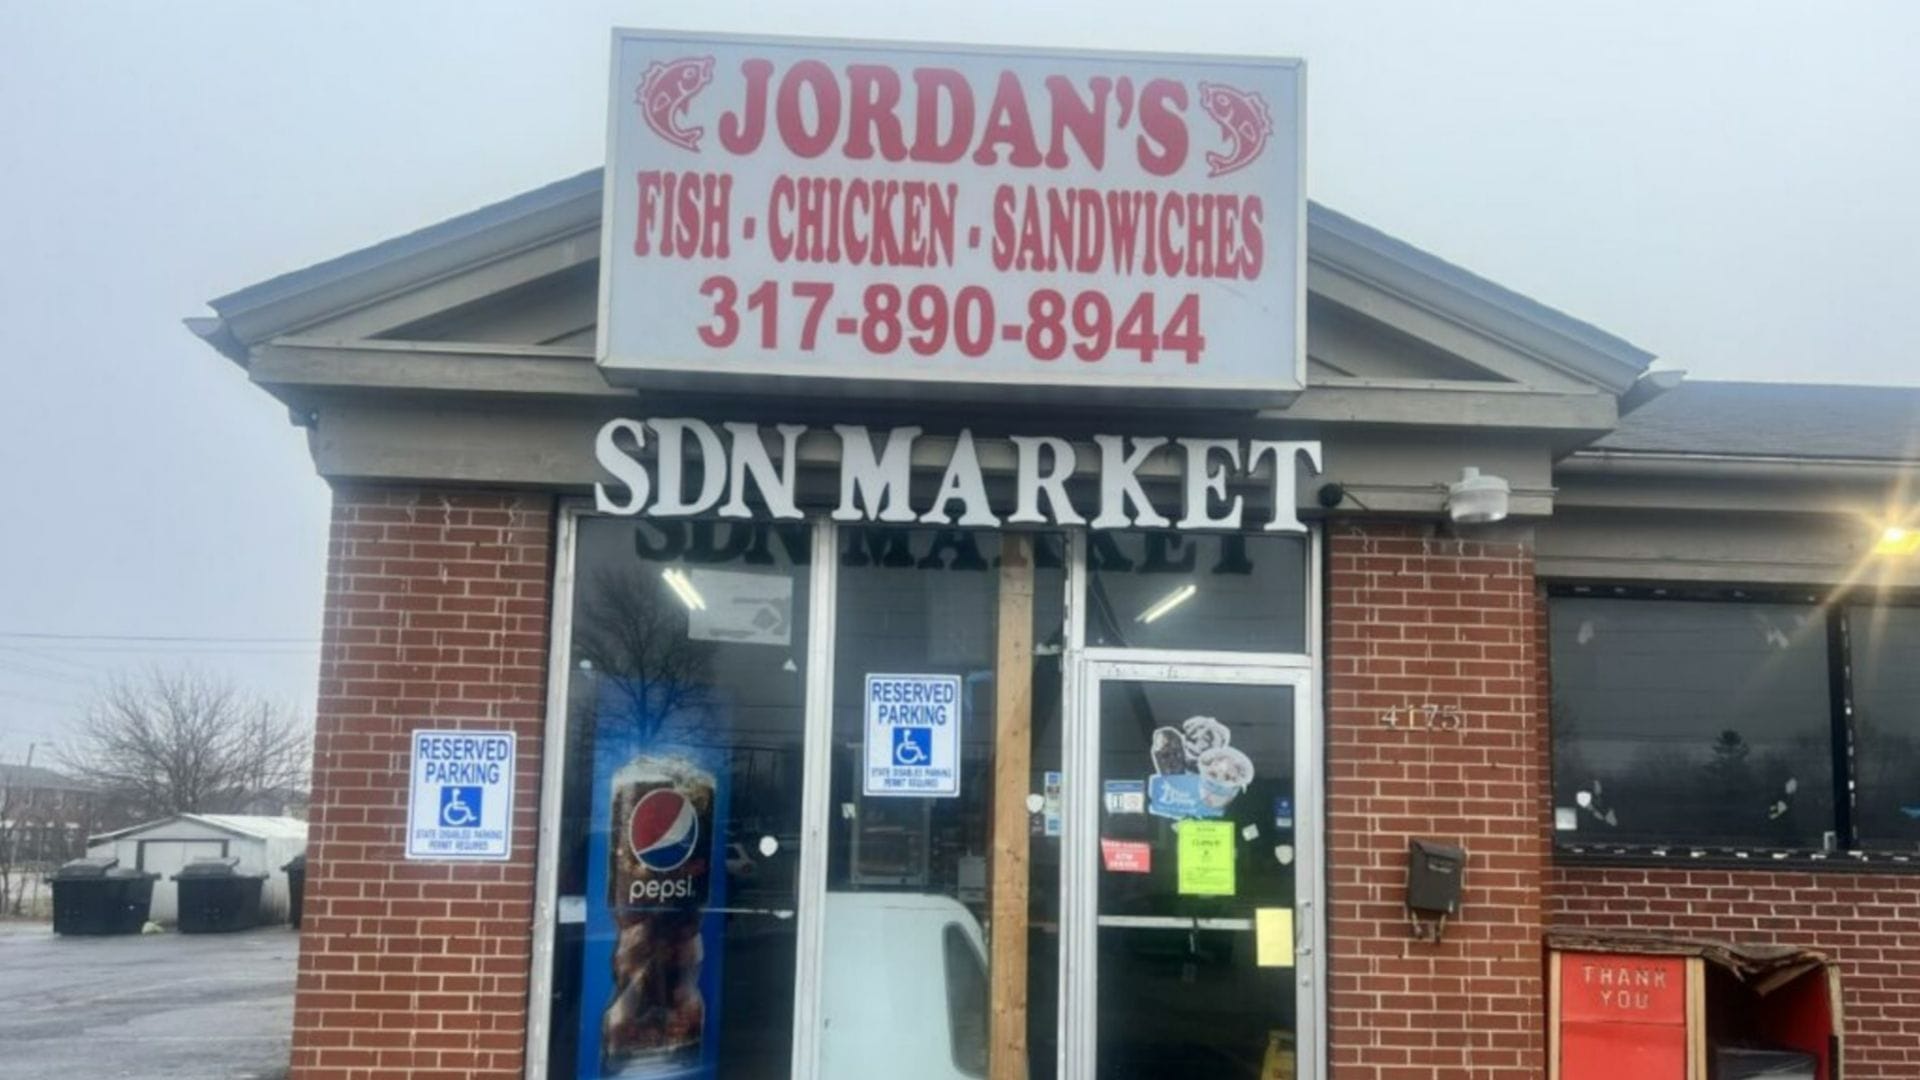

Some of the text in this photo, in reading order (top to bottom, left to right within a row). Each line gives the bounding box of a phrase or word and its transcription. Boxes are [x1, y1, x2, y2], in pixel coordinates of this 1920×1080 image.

[718, 58, 1190, 176] JORDAN'S
[634, 170, 1265, 281] FISH CHICKEN SANDWICHES
[697, 275, 1206, 365] 317-890-8944
[594, 417, 1323, 532] SDN MARKET
[872, 682, 954, 703] RESERVED
[878, 704, 947, 726] PARKING
[1380, 704, 1461, 732] 4175
[420, 738, 508, 761] RESERVED
[425, 761, 500, 784] PARKING
[629, 873, 693, 904] pepsi
[1582, 965, 1667, 989] THANK
[1600, 990, 1649, 1010] YOU
